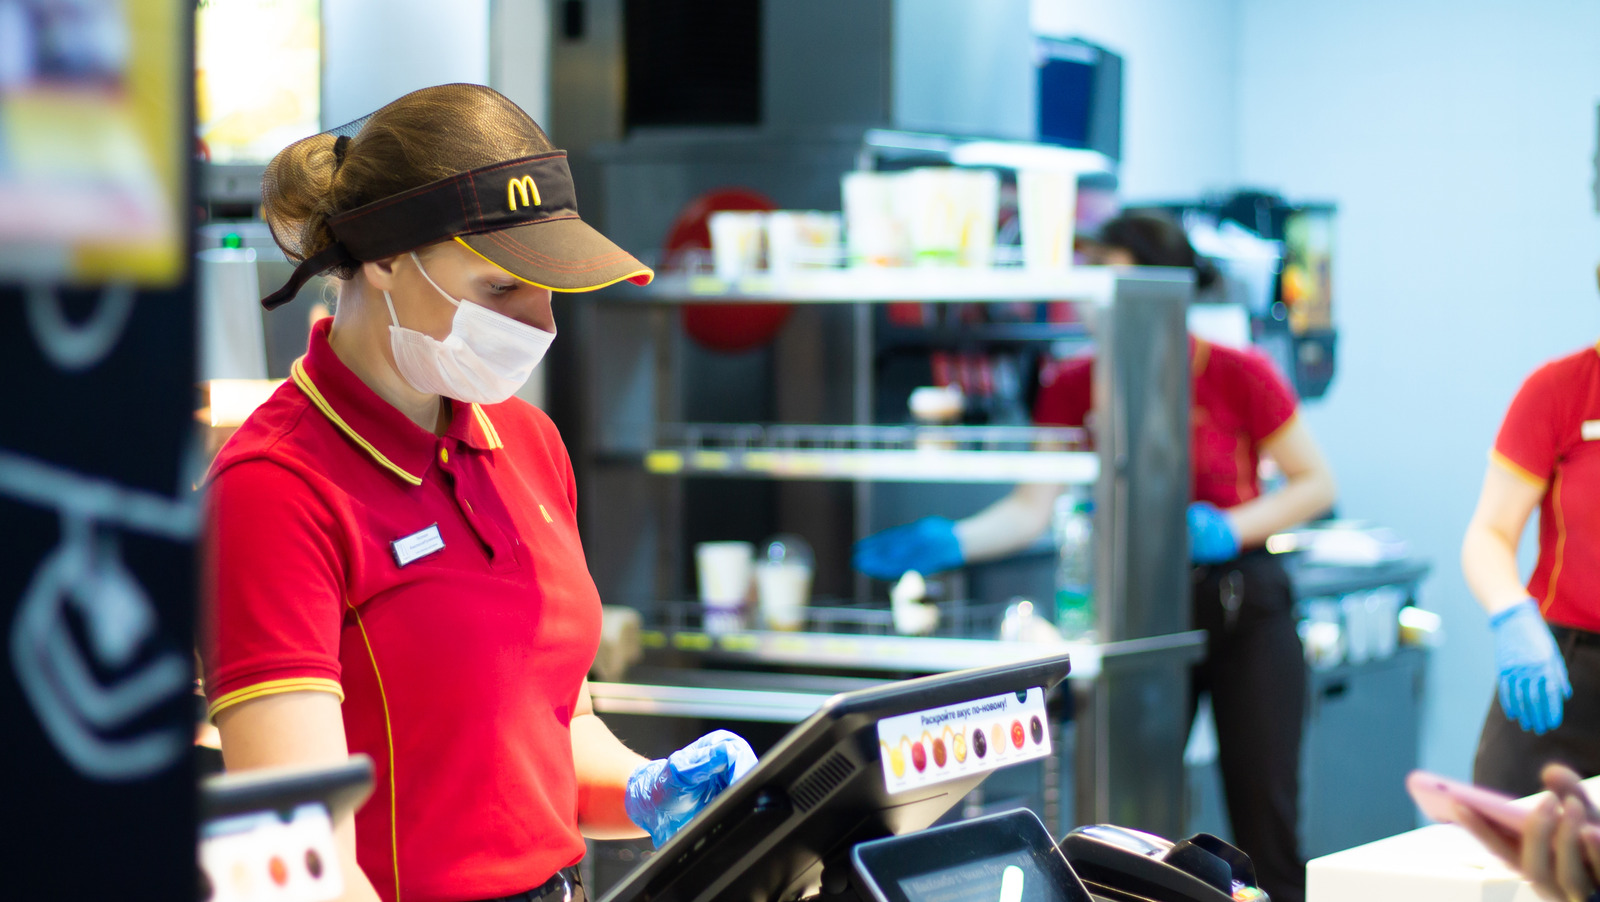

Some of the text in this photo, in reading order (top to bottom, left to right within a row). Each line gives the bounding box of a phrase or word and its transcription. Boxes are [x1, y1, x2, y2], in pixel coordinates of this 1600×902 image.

[921, 697, 1007, 726] Раскройте вкус по-новому!
